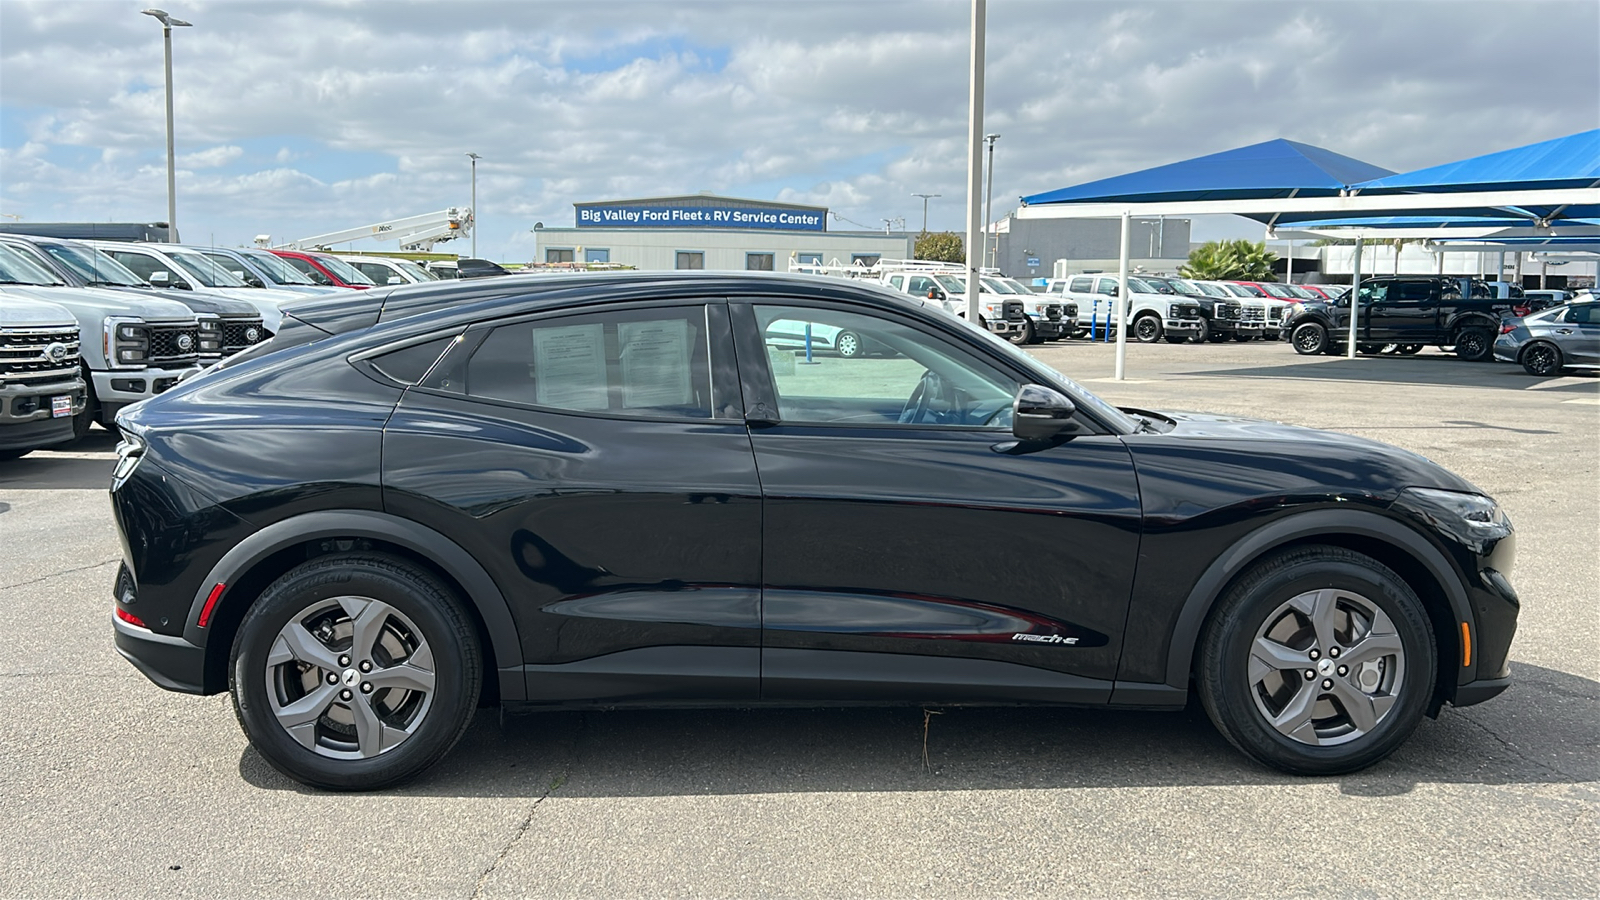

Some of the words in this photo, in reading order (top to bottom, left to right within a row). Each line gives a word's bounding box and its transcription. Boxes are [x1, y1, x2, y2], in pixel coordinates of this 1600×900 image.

[581, 210, 601, 222] Big
[603, 210, 640, 222] Valley
[643, 210, 669, 220] Ford
[672, 210, 702, 220] Fleet
[704, 212, 711, 220] &
[714, 211, 731, 221] RV
[733, 211, 777, 223] Service
[779, 213, 819, 225] Center
